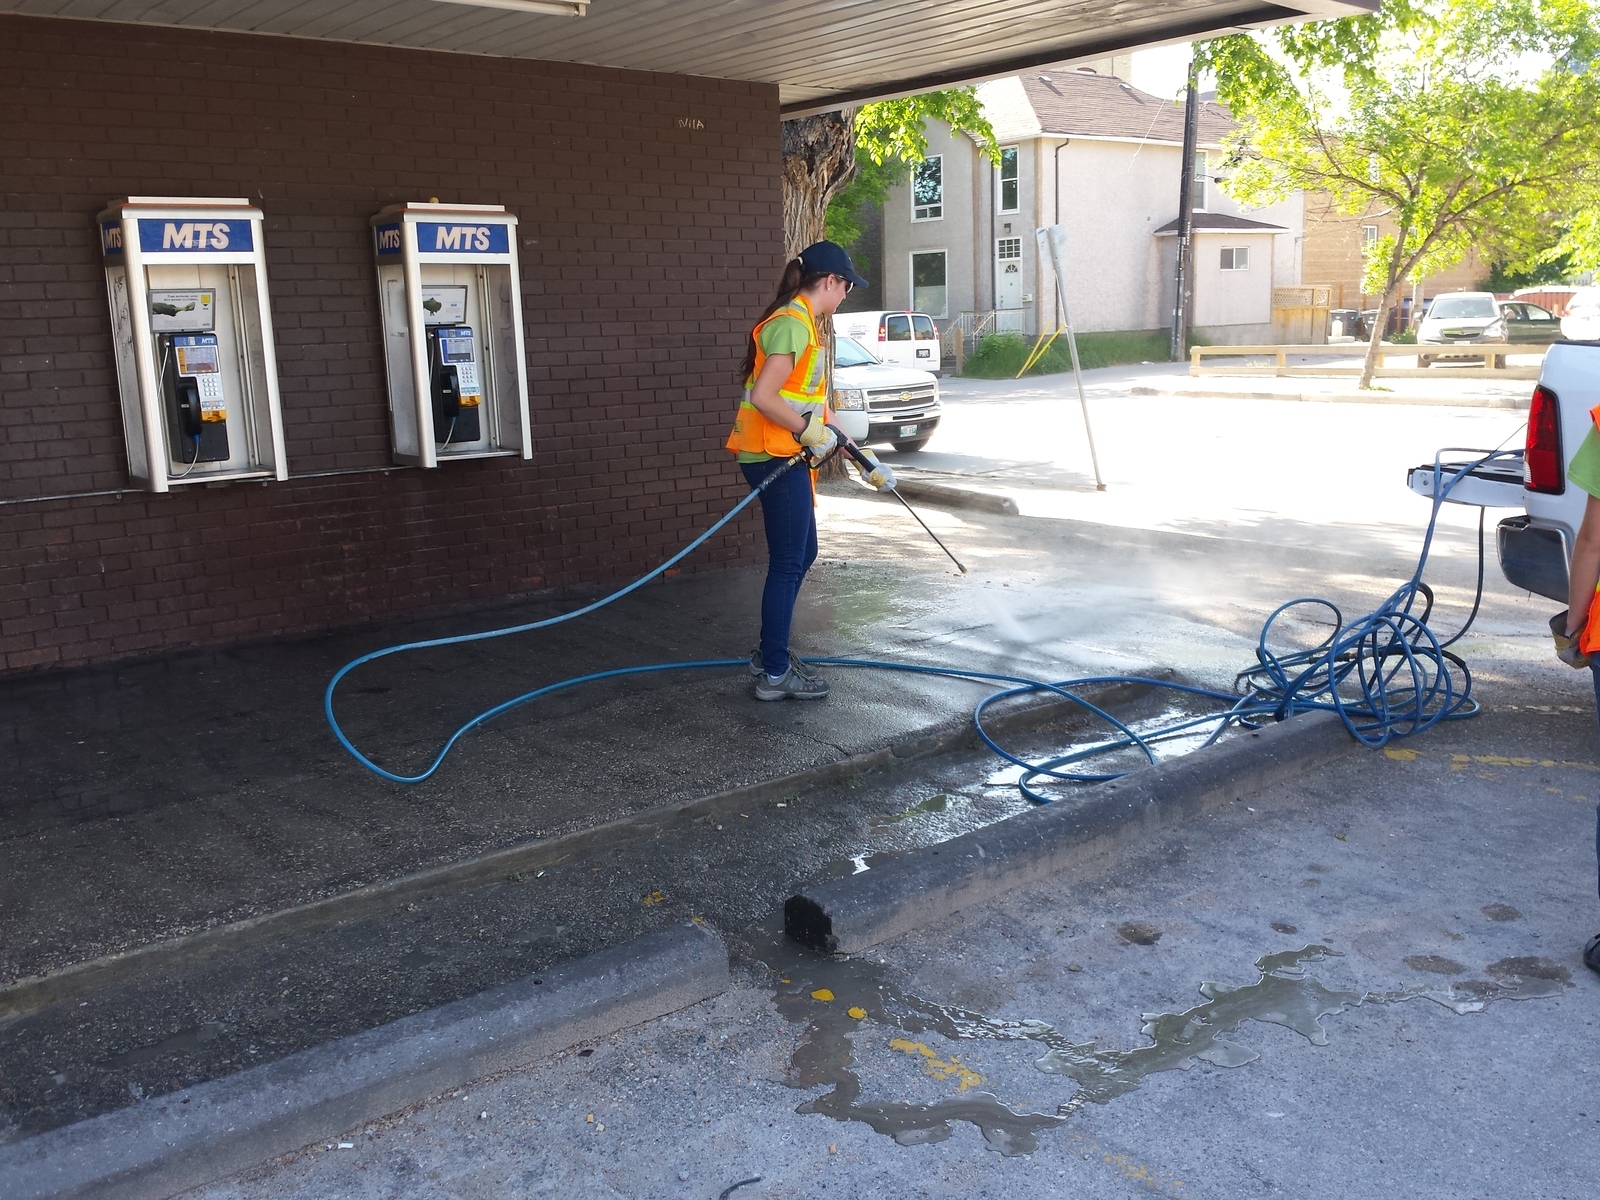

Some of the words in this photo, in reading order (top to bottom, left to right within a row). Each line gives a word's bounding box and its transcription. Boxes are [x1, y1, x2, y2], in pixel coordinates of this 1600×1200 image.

[105, 227, 122, 249] MTS
[162, 223, 231, 250] MTS
[380, 229, 400, 249] MTS
[435, 226, 492, 251] MTS
